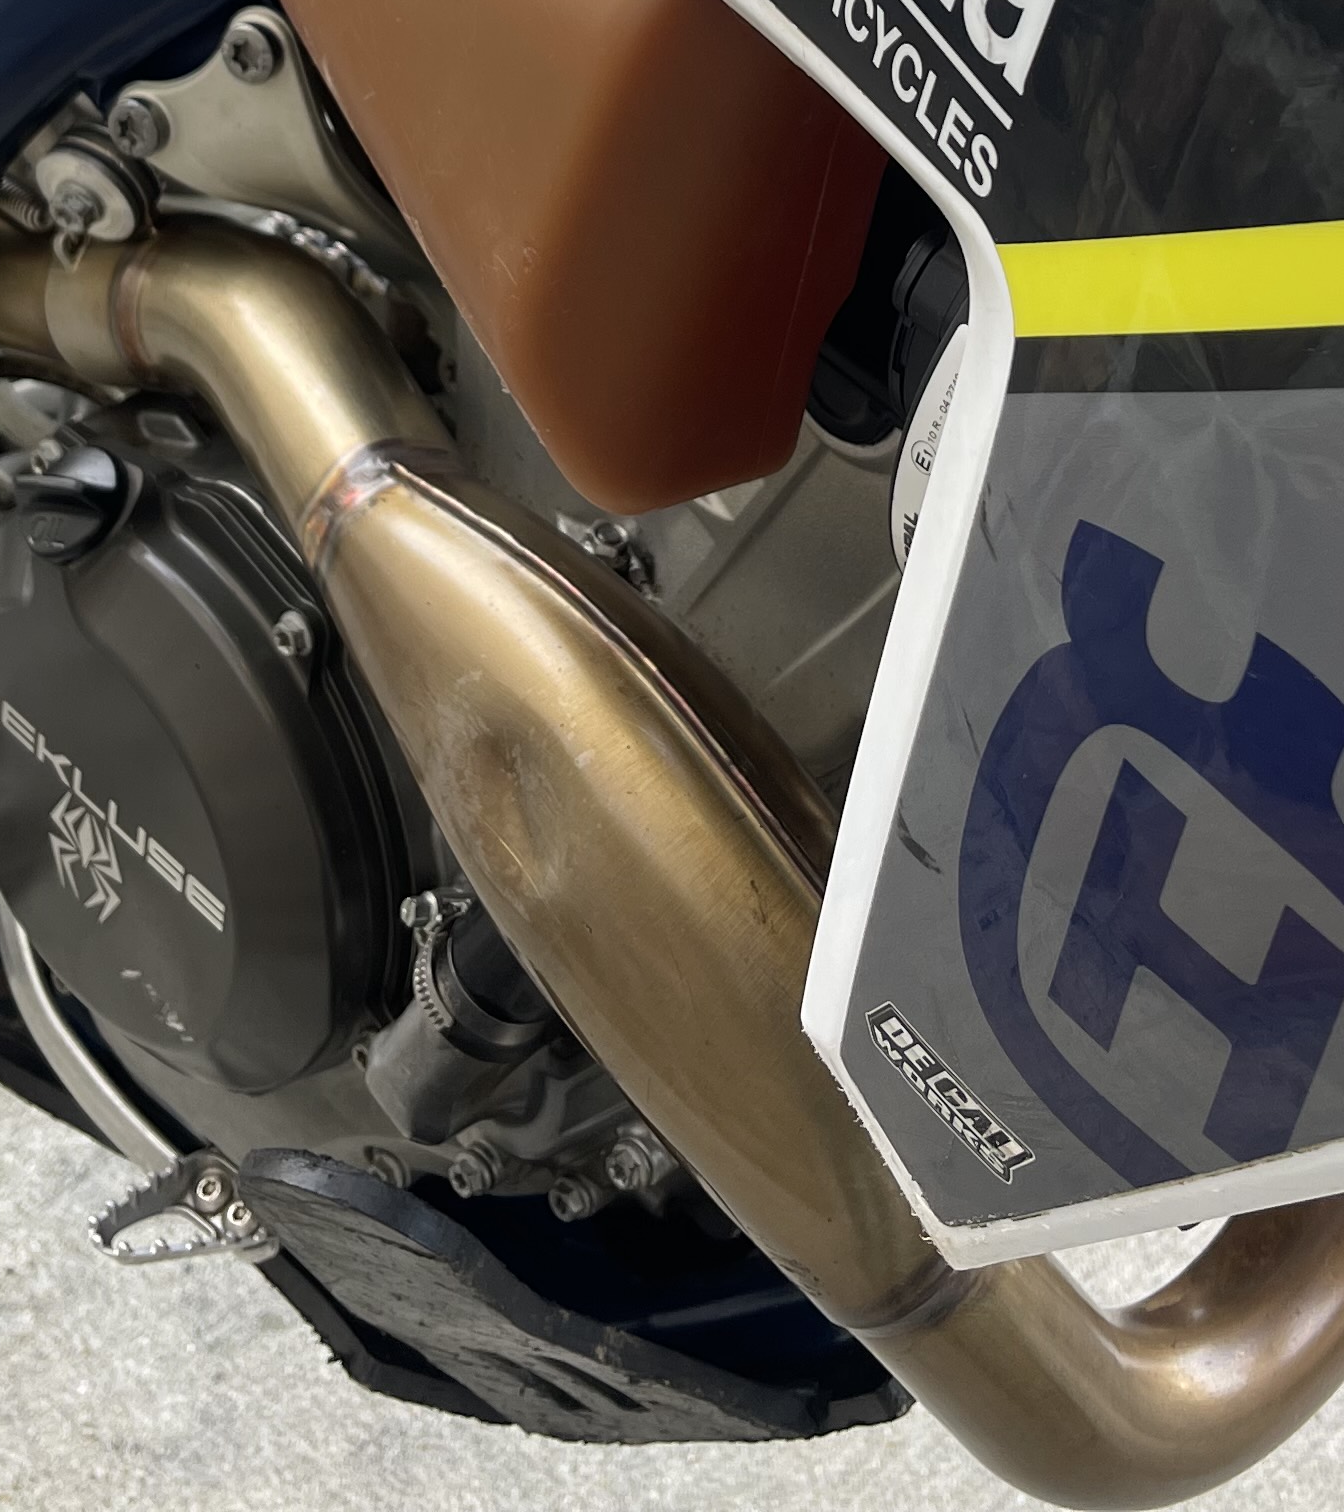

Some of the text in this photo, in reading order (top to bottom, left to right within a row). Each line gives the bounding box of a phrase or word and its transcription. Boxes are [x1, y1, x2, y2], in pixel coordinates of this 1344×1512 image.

[927, 430, 937, 444] 10
[932, 420, 942, 432] R
[873, 1024, 1005, 1175] WORKS
[879, 1016, 1025, 1161] DECAL
